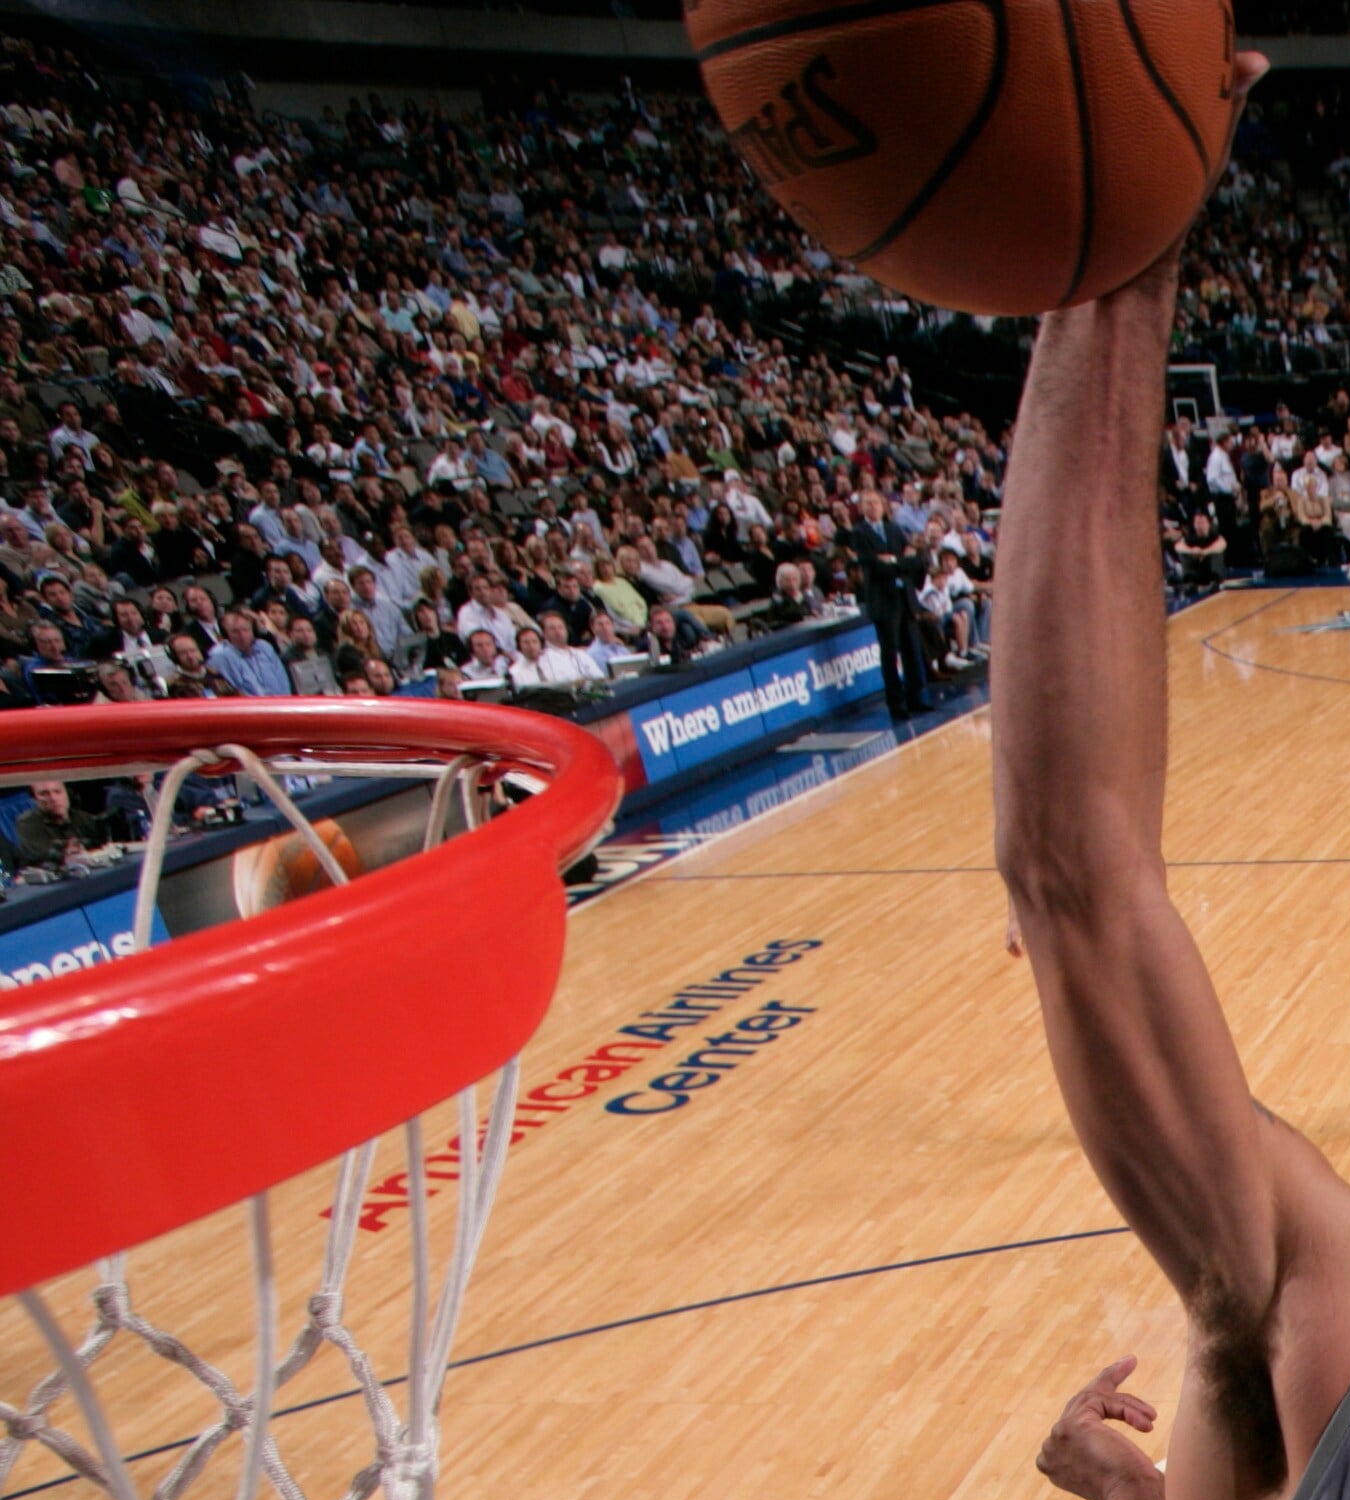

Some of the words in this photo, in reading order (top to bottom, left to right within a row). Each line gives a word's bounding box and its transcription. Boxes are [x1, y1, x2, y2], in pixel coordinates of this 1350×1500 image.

[641, 705, 721, 757] Where
[722, 671, 811, 726] amazing
[808, 642, 881, 691] happens
[604, 999, 818, 1116] Center
